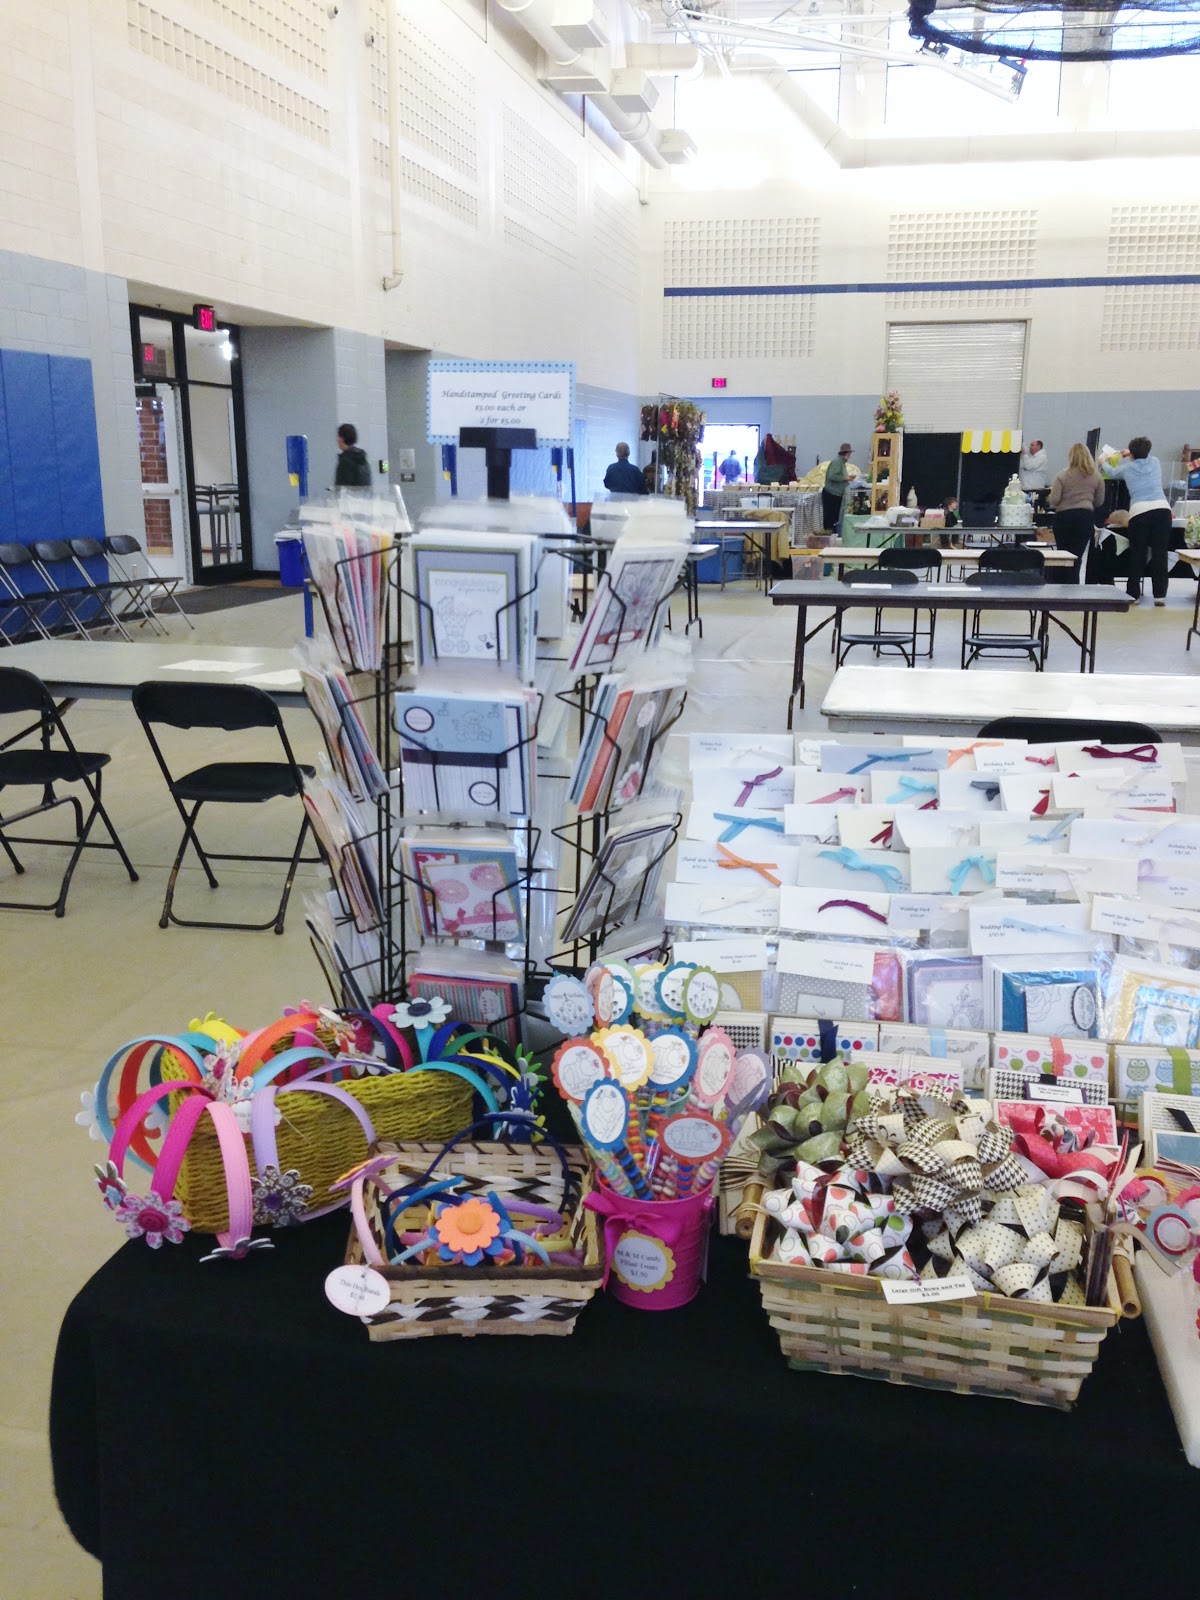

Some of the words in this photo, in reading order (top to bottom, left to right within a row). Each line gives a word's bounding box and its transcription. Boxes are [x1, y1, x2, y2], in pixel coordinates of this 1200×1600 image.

[441, 389, 499, 401] Handstamped
[501, 390, 536, 401] Greeting
[538, 390, 562, 400] Cards
[475, 404, 495, 412] $3.00
[496, 402, 516, 412] each
[485, 415, 499, 426] for
[500, 417, 522, 425] $5.00
[979, 923, 1002, 931] Wedding
[641, 1254, 661, 1263] Candy
[620, 1258, 638, 1268] Filled
[640, 1262, 658, 1270] Treats
